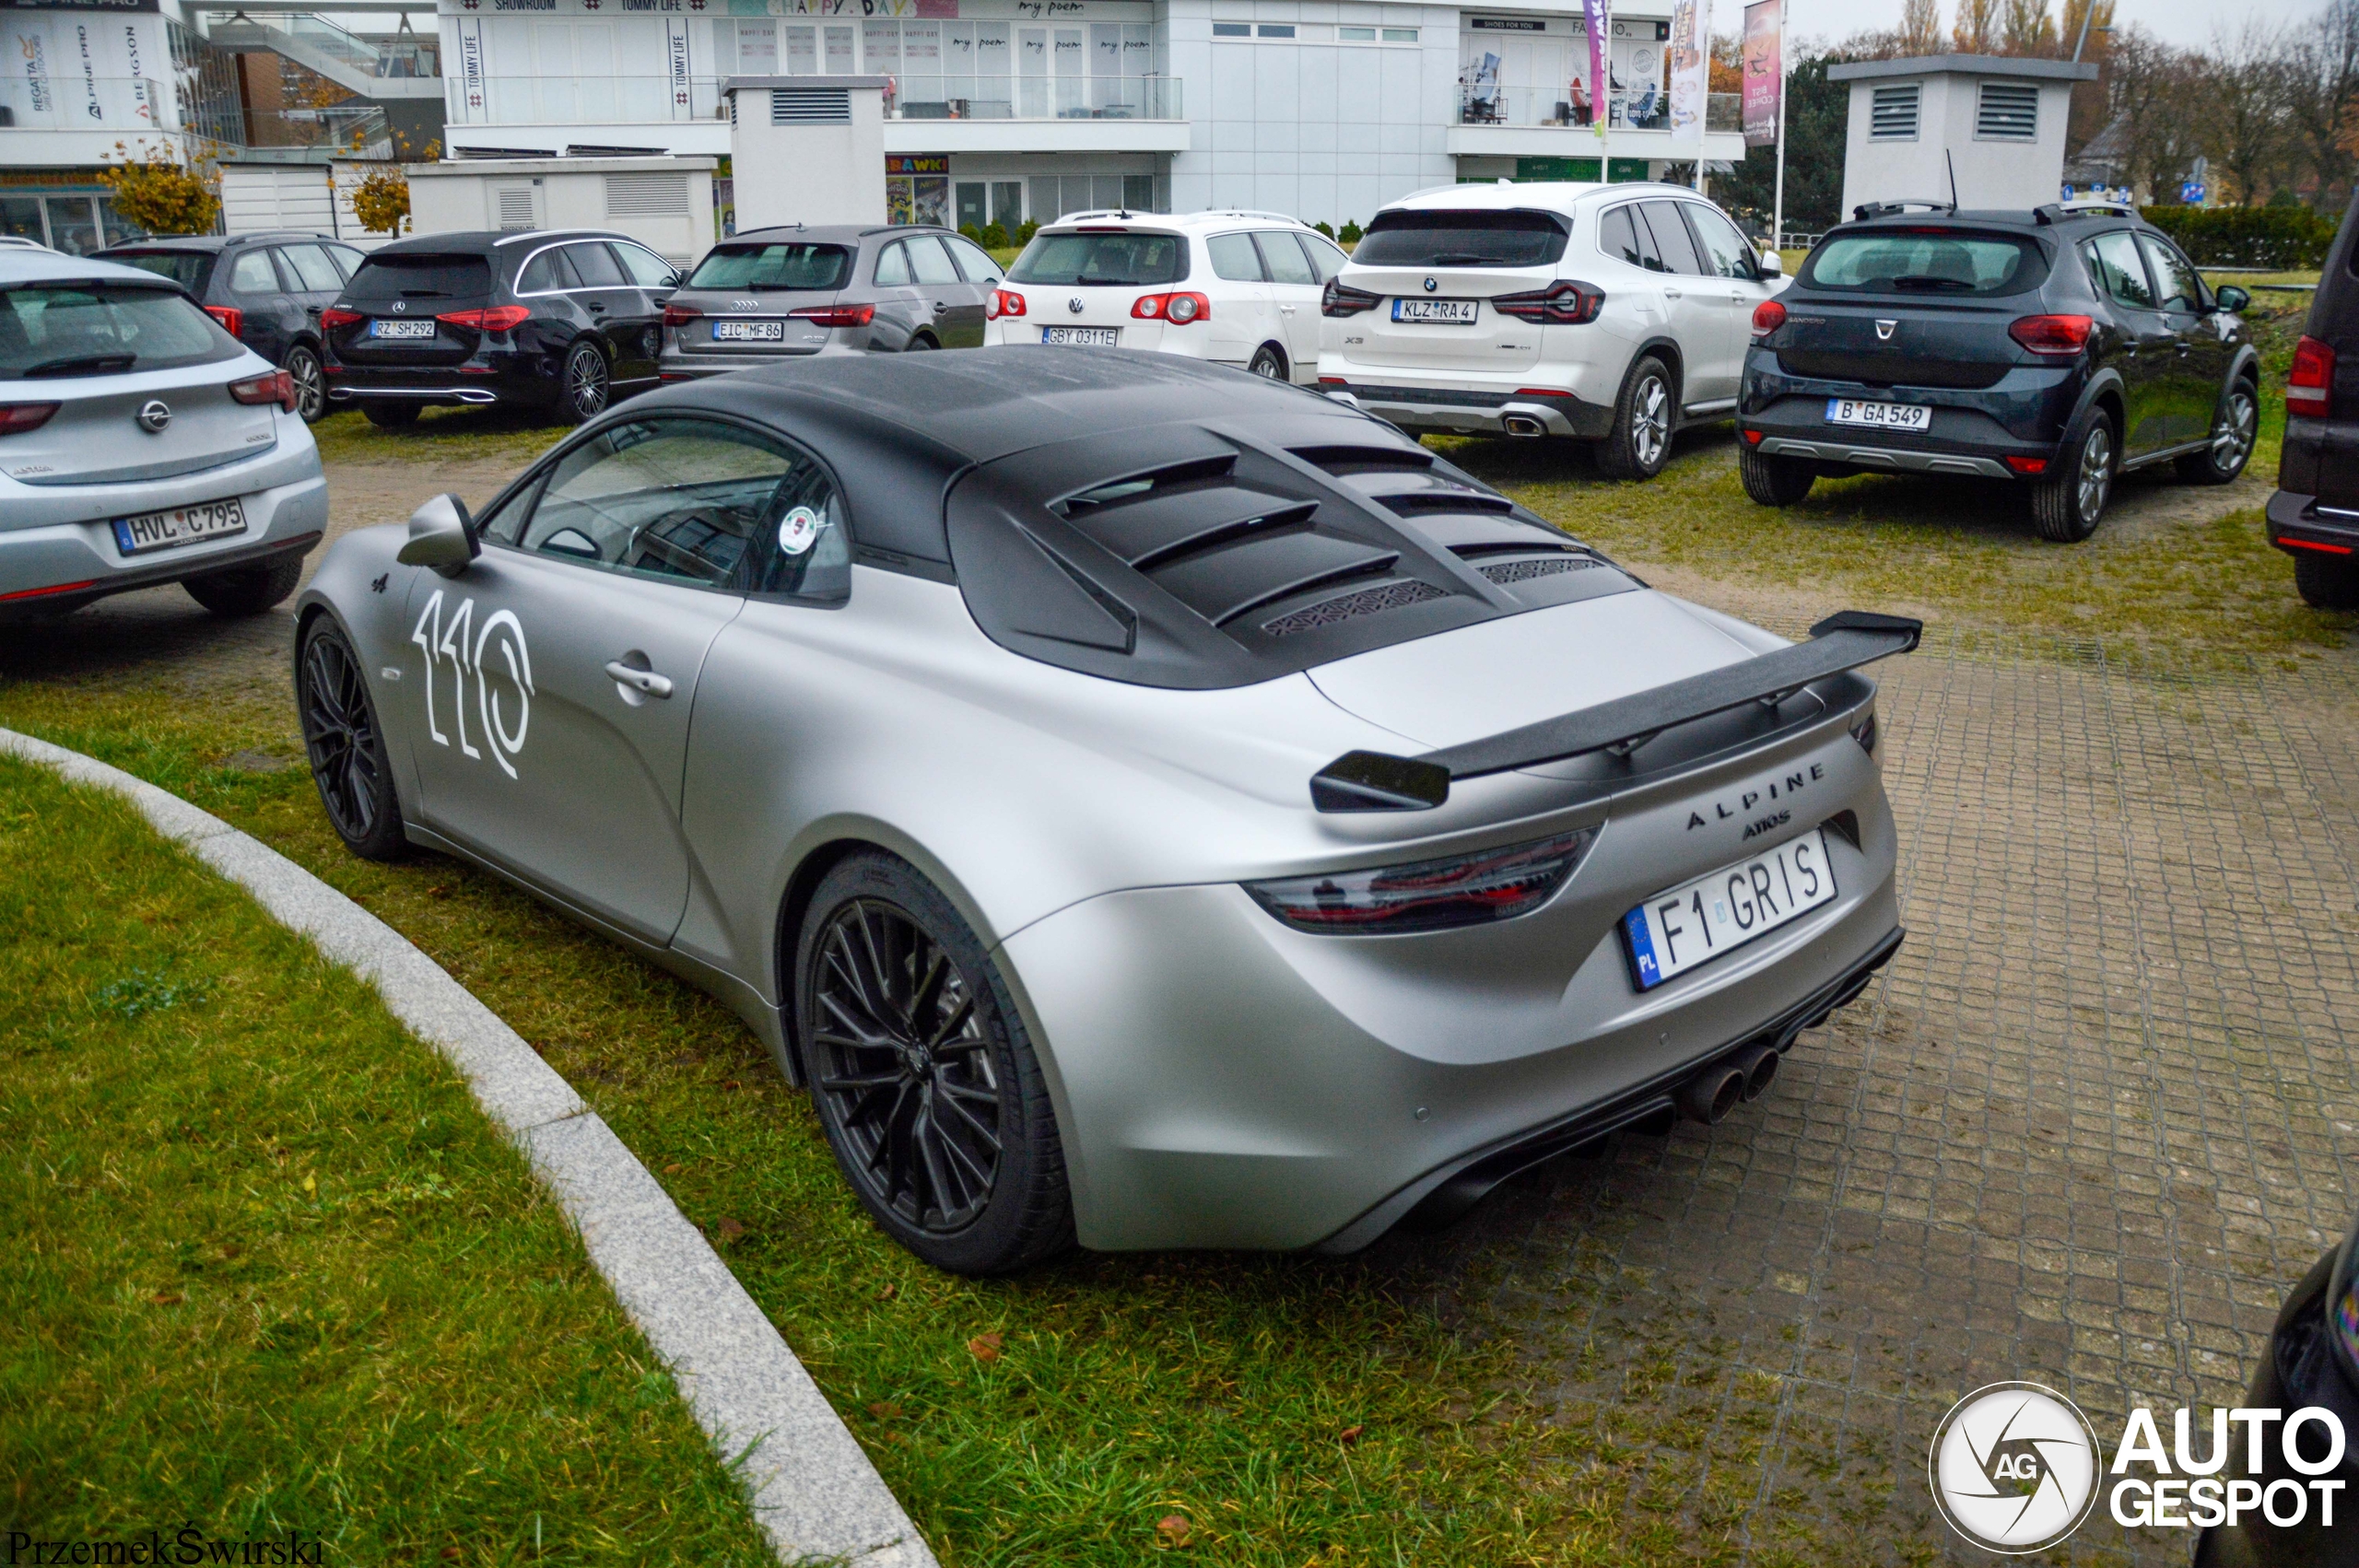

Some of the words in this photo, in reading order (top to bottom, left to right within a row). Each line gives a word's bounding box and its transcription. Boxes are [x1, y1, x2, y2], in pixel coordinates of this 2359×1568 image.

[496, 0, 556, 11] SHOWROOM
[622, 0, 658, 11] TOMMY
[661, 0, 682, 11] LIFE
[782, 0, 844, 15] HAPPY
[861, 0, 906, 16] DAY
[1018, 2, 1044, 18] my
[1048, 1, 1084, 16] poem
[77, 25, 90, 58] PRO
[464, 35, 476, 53] LIFE
[673, 35, 684, 53] LIFE
[953, 38, 972, 51] my
[979, 38, 1006, 50] poem
[1027, 41, 1044, 53] my
[1055, 41, 1083, 53] poem
[1100, 41, 1118, 54] my
[1123, 41, 1150, 53] poem
[125, 27, 145, 100] BERGSON
[466, 54, 480, 88] TOMMY
[675, 54, 687, 87] TOMMY
[27, 61, 44, 111] REGATTA
[84, 62, 102, 120] ALPINE
[886, 158, 947, 172] BAWKI
[1404, 302, 1431, 317] KLZ
[377, 322, 391, 334] RZ
[720, 324, 742, 336] EIC
[1050, 329, 1074, 344] GBY
[1075, 330, 1115, 345] 0311E
[1841, 403, 1853, 419] B
[130, 515, 178, 544] HVL
[412, 590, 536, 780] 110
[1687, 763, 1825, 830] ALPINE
[1743, 810, 1791, 840] A110S
[1659, 890, 1713, 965] F1
[1727, 843, 1819, 930] GRIS
[1638, 953, 1657, 974] PL
